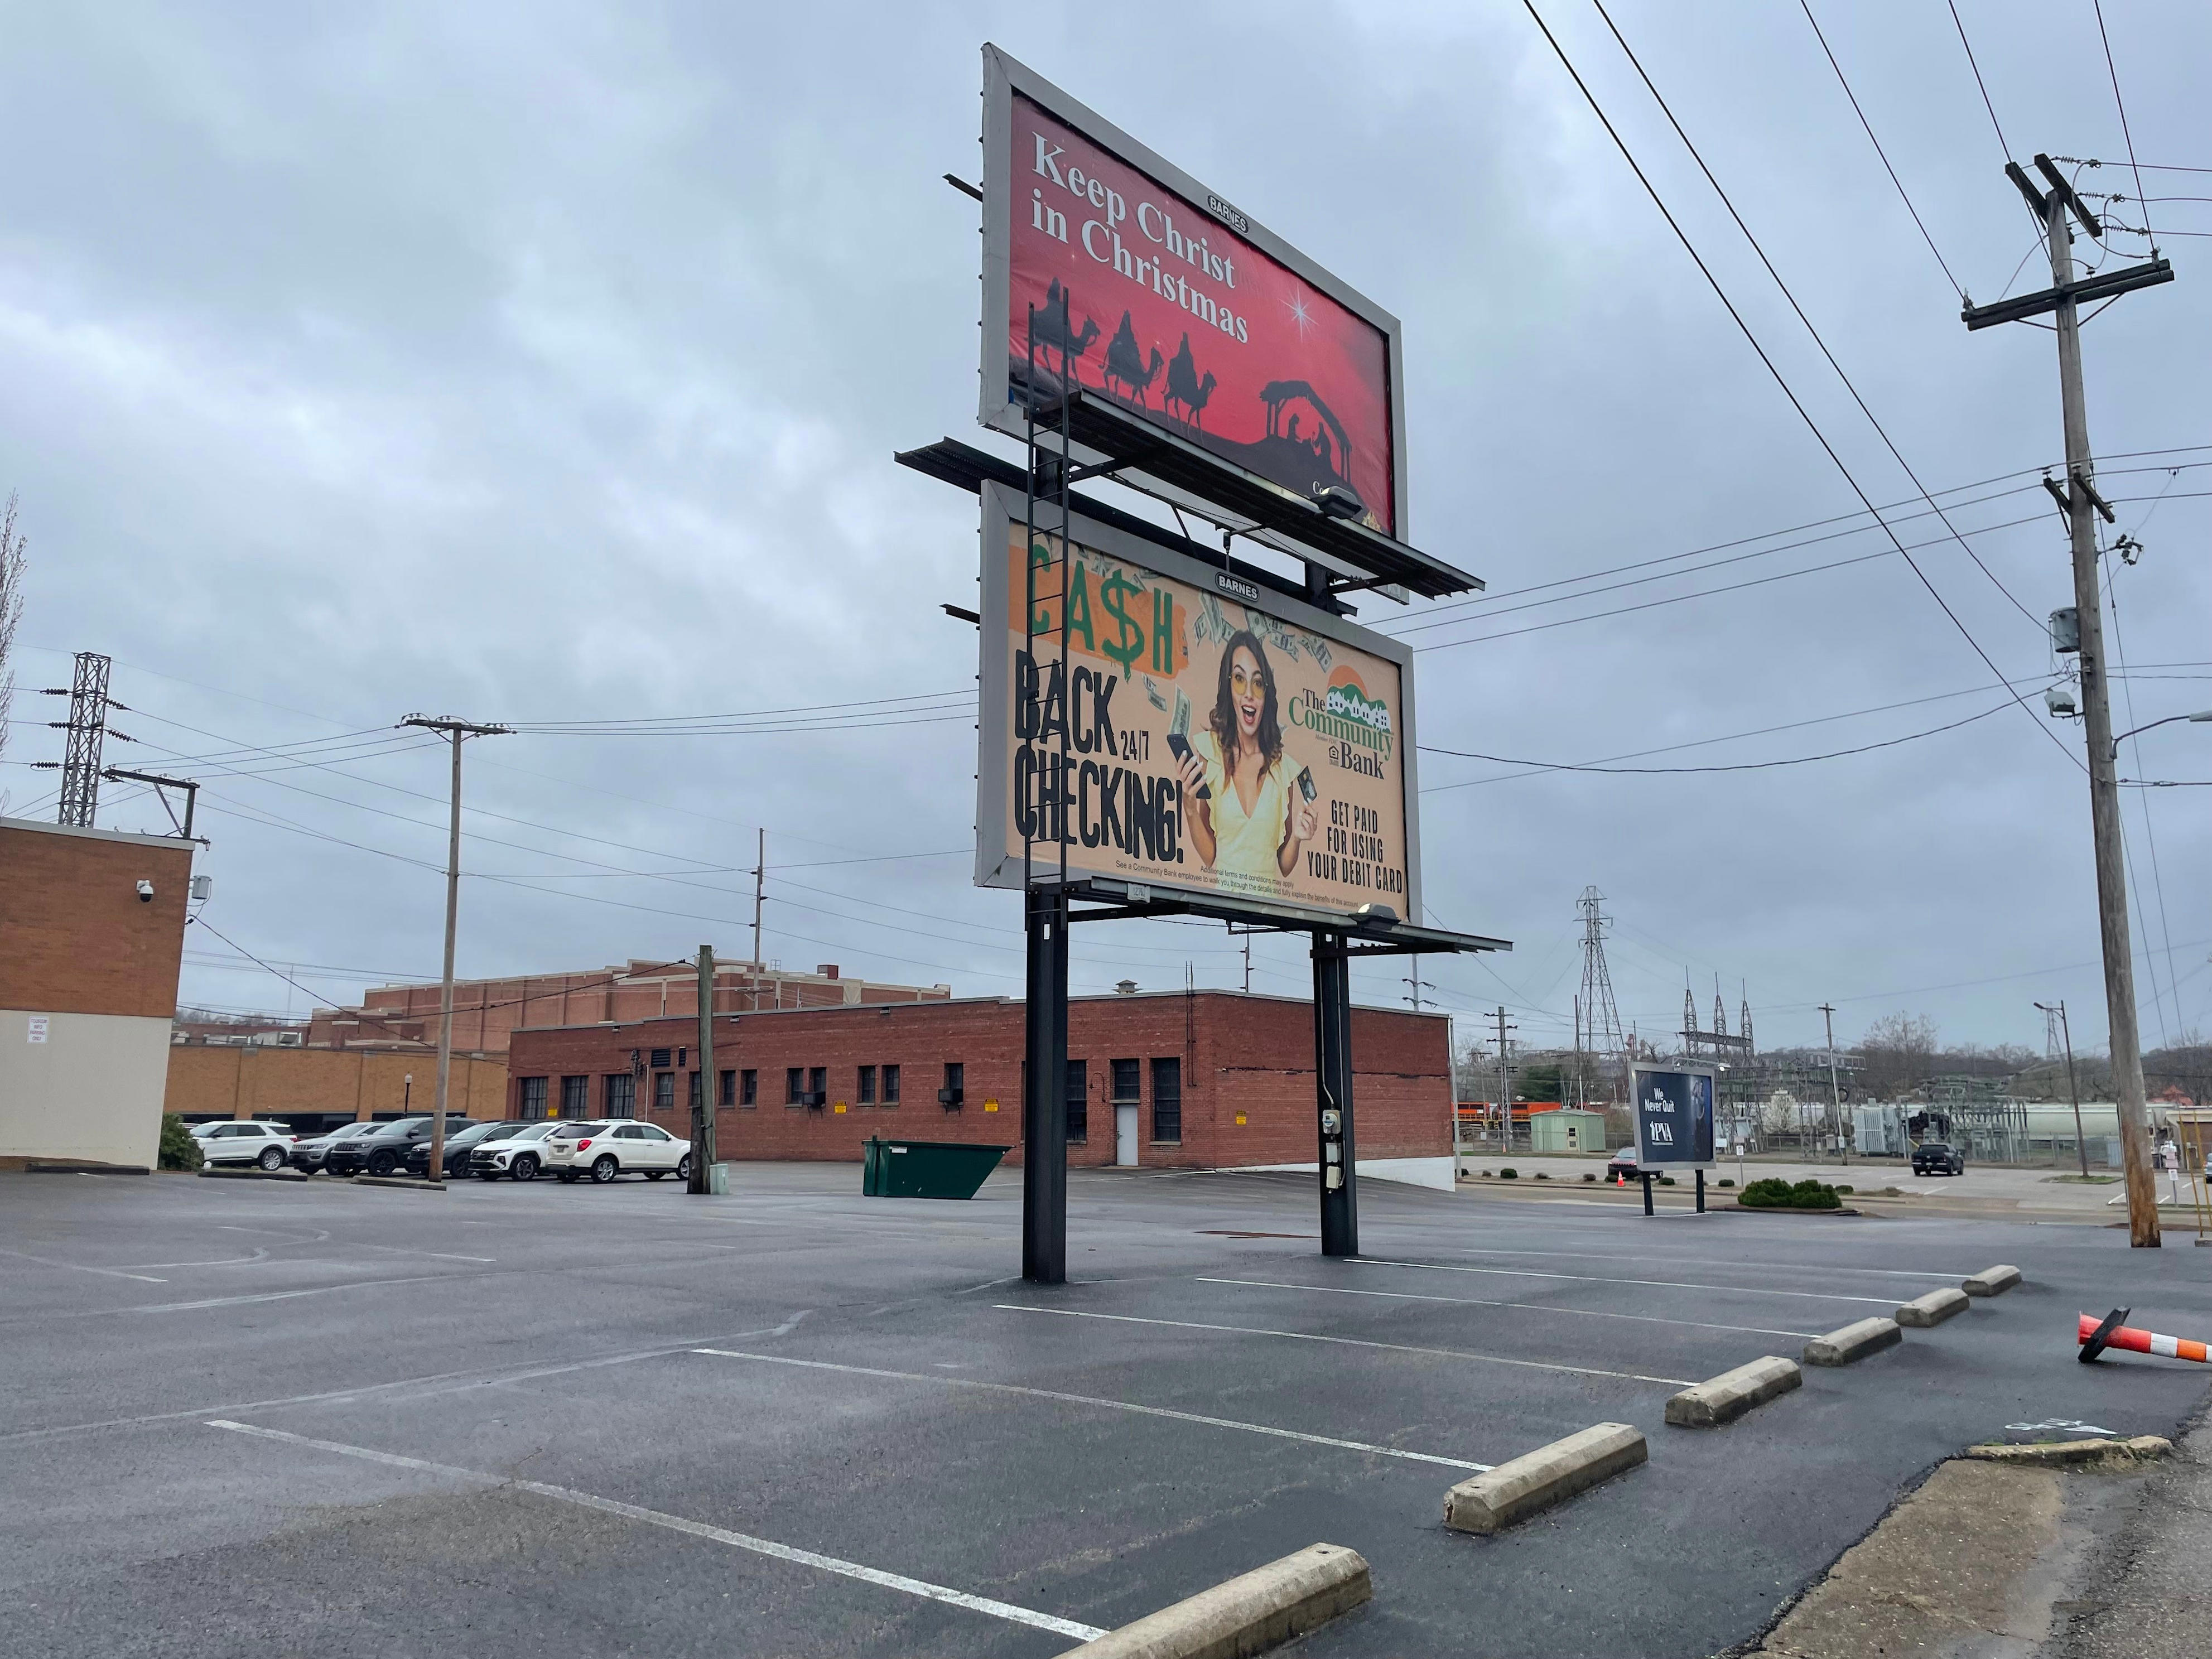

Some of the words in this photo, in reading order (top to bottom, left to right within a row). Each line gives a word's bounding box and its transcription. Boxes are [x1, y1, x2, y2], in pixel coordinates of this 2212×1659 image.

[1032, 131, 1126, 229] Keep
[1138, 202, 1235, 289] Christ
[1209, 196, 1246, 232] BARNES
[1031, 188, 1068, 244] in
[1082, 219, 1248, 344] Christmas
[1218, 575, 1257, 599] BARNES
[1030, 544, 1173, 684] CA$H
[1014, 649, 1117, 756] BACK
[1303, 688, 1326, 712] The
[1289, 696, 1394, 761] Community
[1340, 741, 1384, 780] Bank
[1014, 745, 1183, 864] CHECKING!
[1331, 799, 1349, 827] GET
[1354, 806, 1377, 834] PAID
[1327, 826, 1347, 855] FOR
[1352, 832, 1383, 863] USING
[1116, 860, 1127, 869] See
[1133, 863, 1163, 876] Community
[1164, 868, 1177, 877] Bank
[1178, 872, 1202, 882] employee
[1230, 880, 1248, 890] through
[1257, 885, 1272, 893] details
[1281, 888, 1290, 898] fully
[1200, 865, 1223, 875] Additional
[1225, 870, 1237, 879] terms
[1249, 875, 1271, 884] conditions
[1282, 880, 1294, 889] apply
[1307, 850, 1337, 881] YOUR
[1342, 858, 1370, 888] DEBIT
[1376, 865, 1402, 894] CARD
[1645, 1098, 1662, 1112] Never
[1662, 1099, 1675, 1112] Quit
[1654, 1088, 1664, 1101] We
[1654, 1122, 1673, 1141] PVA
